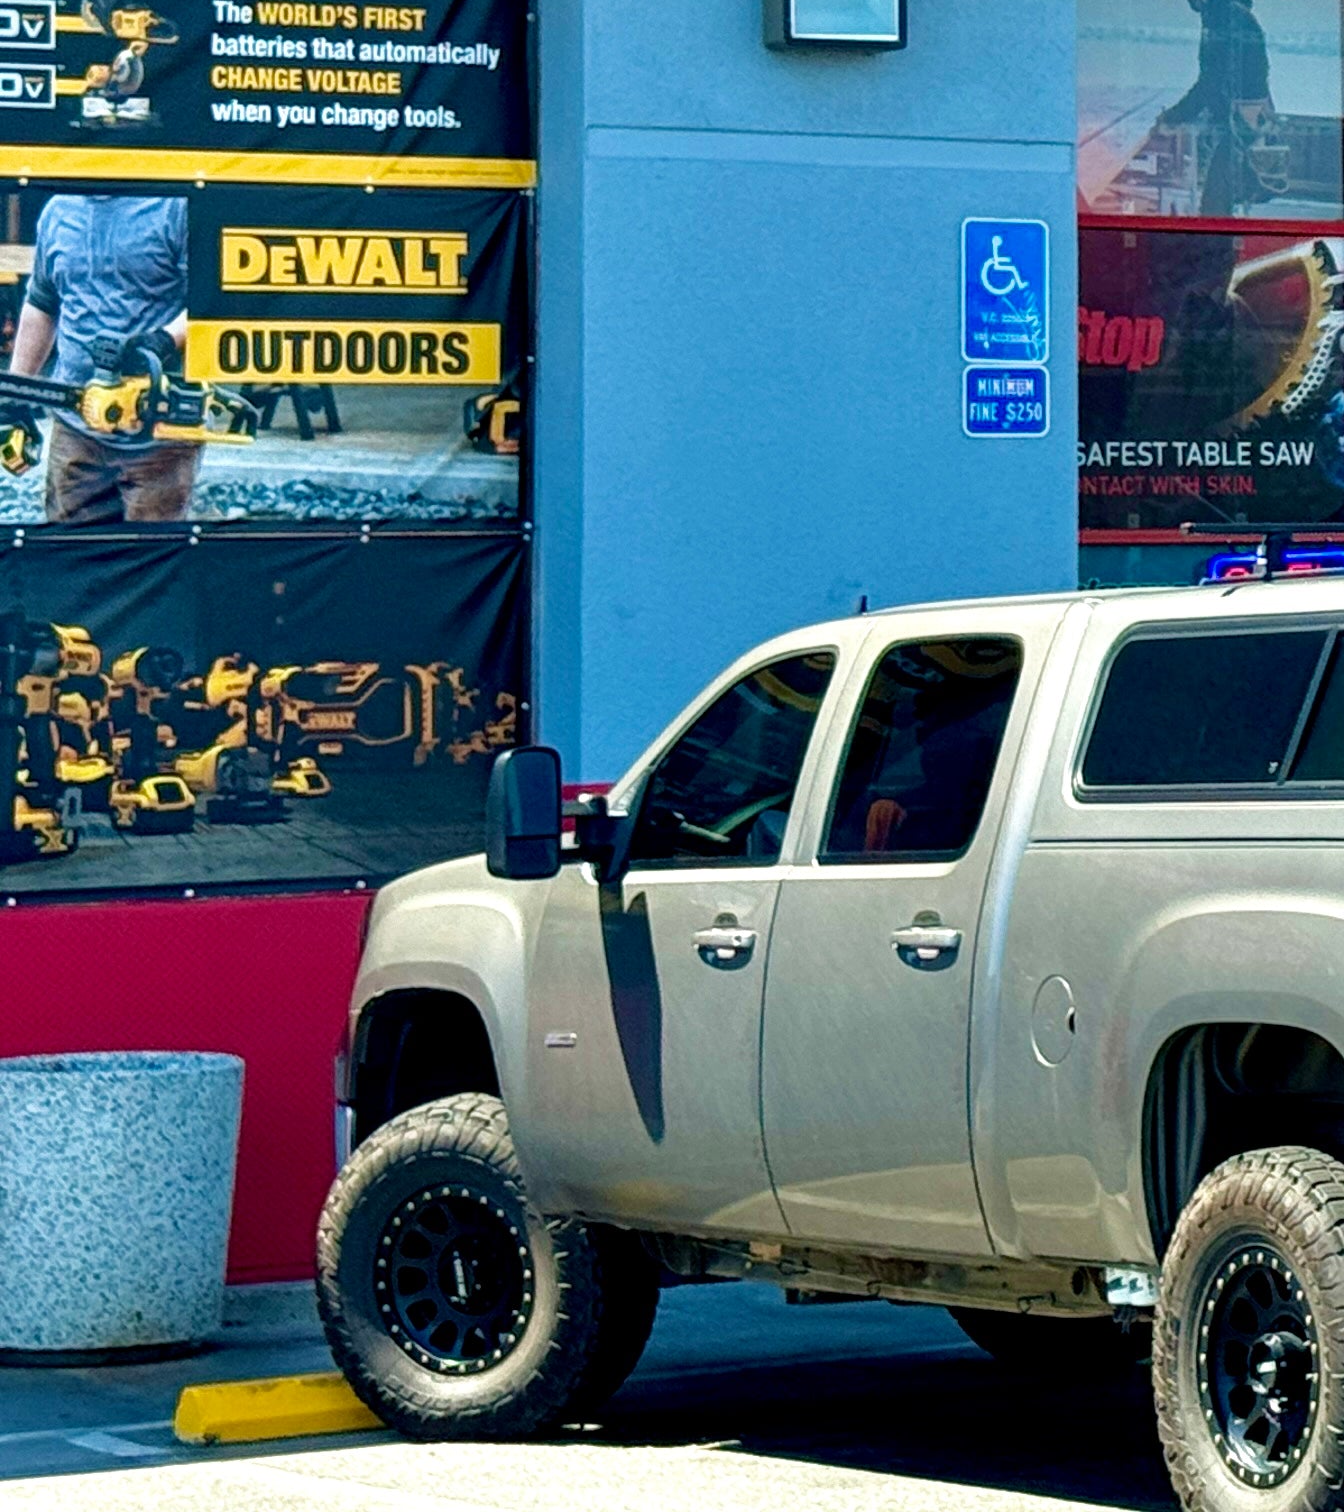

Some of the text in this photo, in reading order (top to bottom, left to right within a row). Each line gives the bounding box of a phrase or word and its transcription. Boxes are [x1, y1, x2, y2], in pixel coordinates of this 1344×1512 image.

[213, 0, 427, 30] The WORLD'S FIRST
[211, 33, 500, 70] batteries that automatically
[211, 65, 402, 94] CHANGE VOLTAGE
[211, 99, 462, 132] when you change tools.
[218, 329, 470, 375] OUTDOORS
[977, 377, 1035, 397] MINIMUM
[969, 401, 1043, 422] FINE $250
[1077, 441, 1315, 467] SAFEST TABLE SAW
[1078, 475, 1144, 495] NTACT
[1150, 475, 1200, 495] WITH
